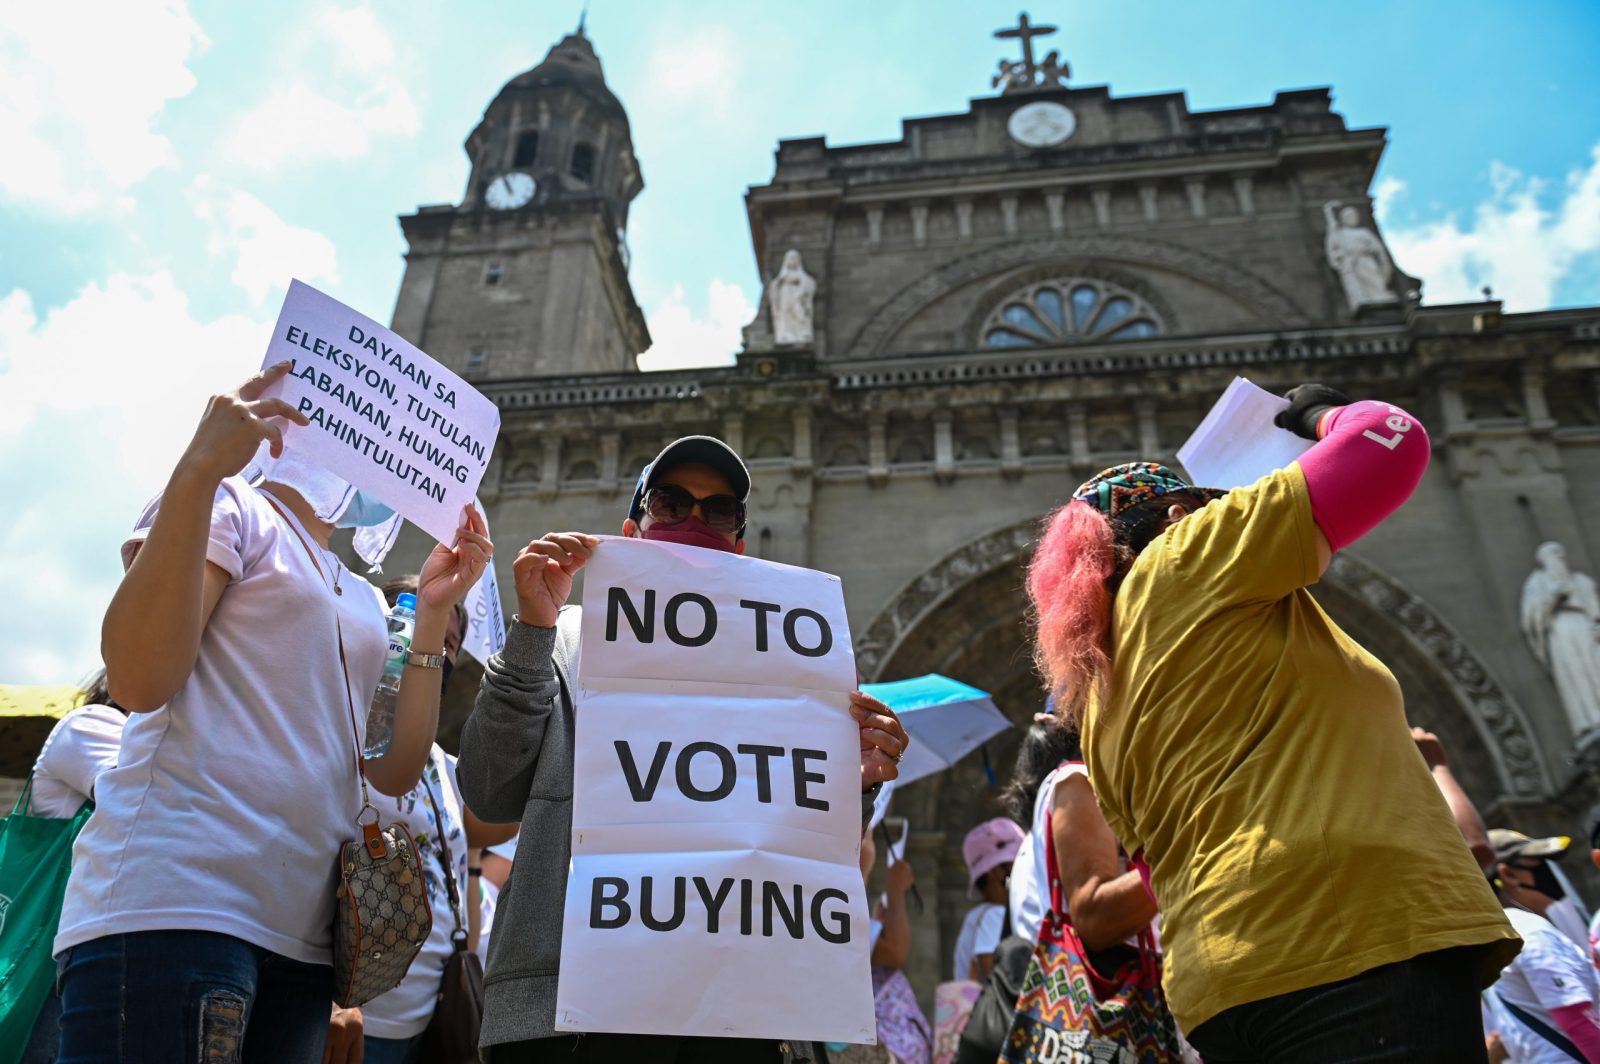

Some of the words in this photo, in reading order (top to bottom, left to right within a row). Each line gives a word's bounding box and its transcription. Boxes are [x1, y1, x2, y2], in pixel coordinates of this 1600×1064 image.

[285, 325, 399, 406] ELEKSYON,
[406, 394, 486, 467] TUTULAN,
[348, 325, 432, 390] DAYAAN
[434, 382, 456, 409] SA
[289, 358, 393, 437] LABANAN,
[398, 425, 469, 484] HUWAG
[298, 396, 447, 504] PAHINTULUTAN
[605, 586, 718, 648] NO
[740, 599, 833, 658] TO
[613, 740, 830, 812] VOTE
[589, 876, 852, 944] BUYING
